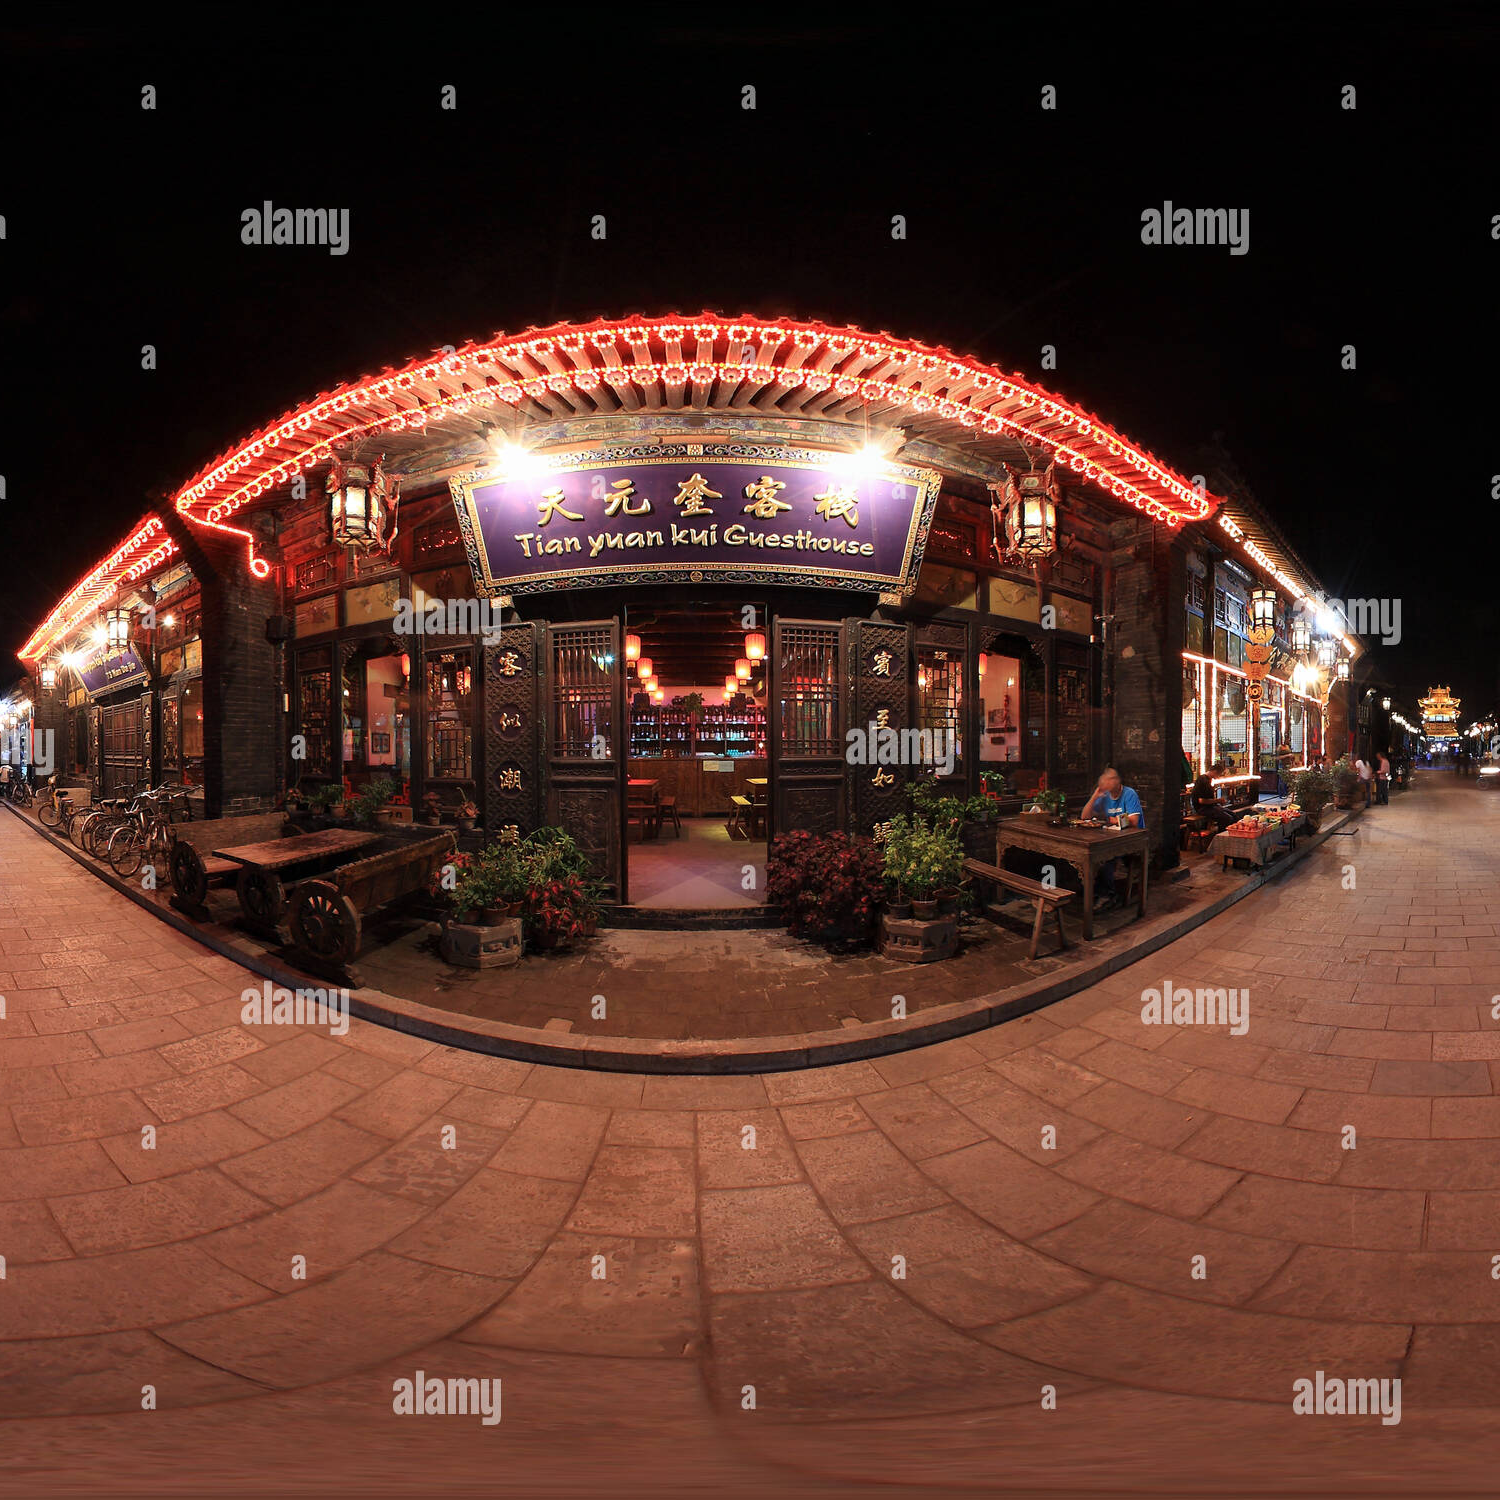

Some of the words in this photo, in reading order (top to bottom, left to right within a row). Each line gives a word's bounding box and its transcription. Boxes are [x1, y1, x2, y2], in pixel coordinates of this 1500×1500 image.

[514, 532, 582, 558] Tian
[588, 531, 664, 558] yuan
[671, 523, 718, 547] kui
[724, 524, 874, 556] Guesthouse
